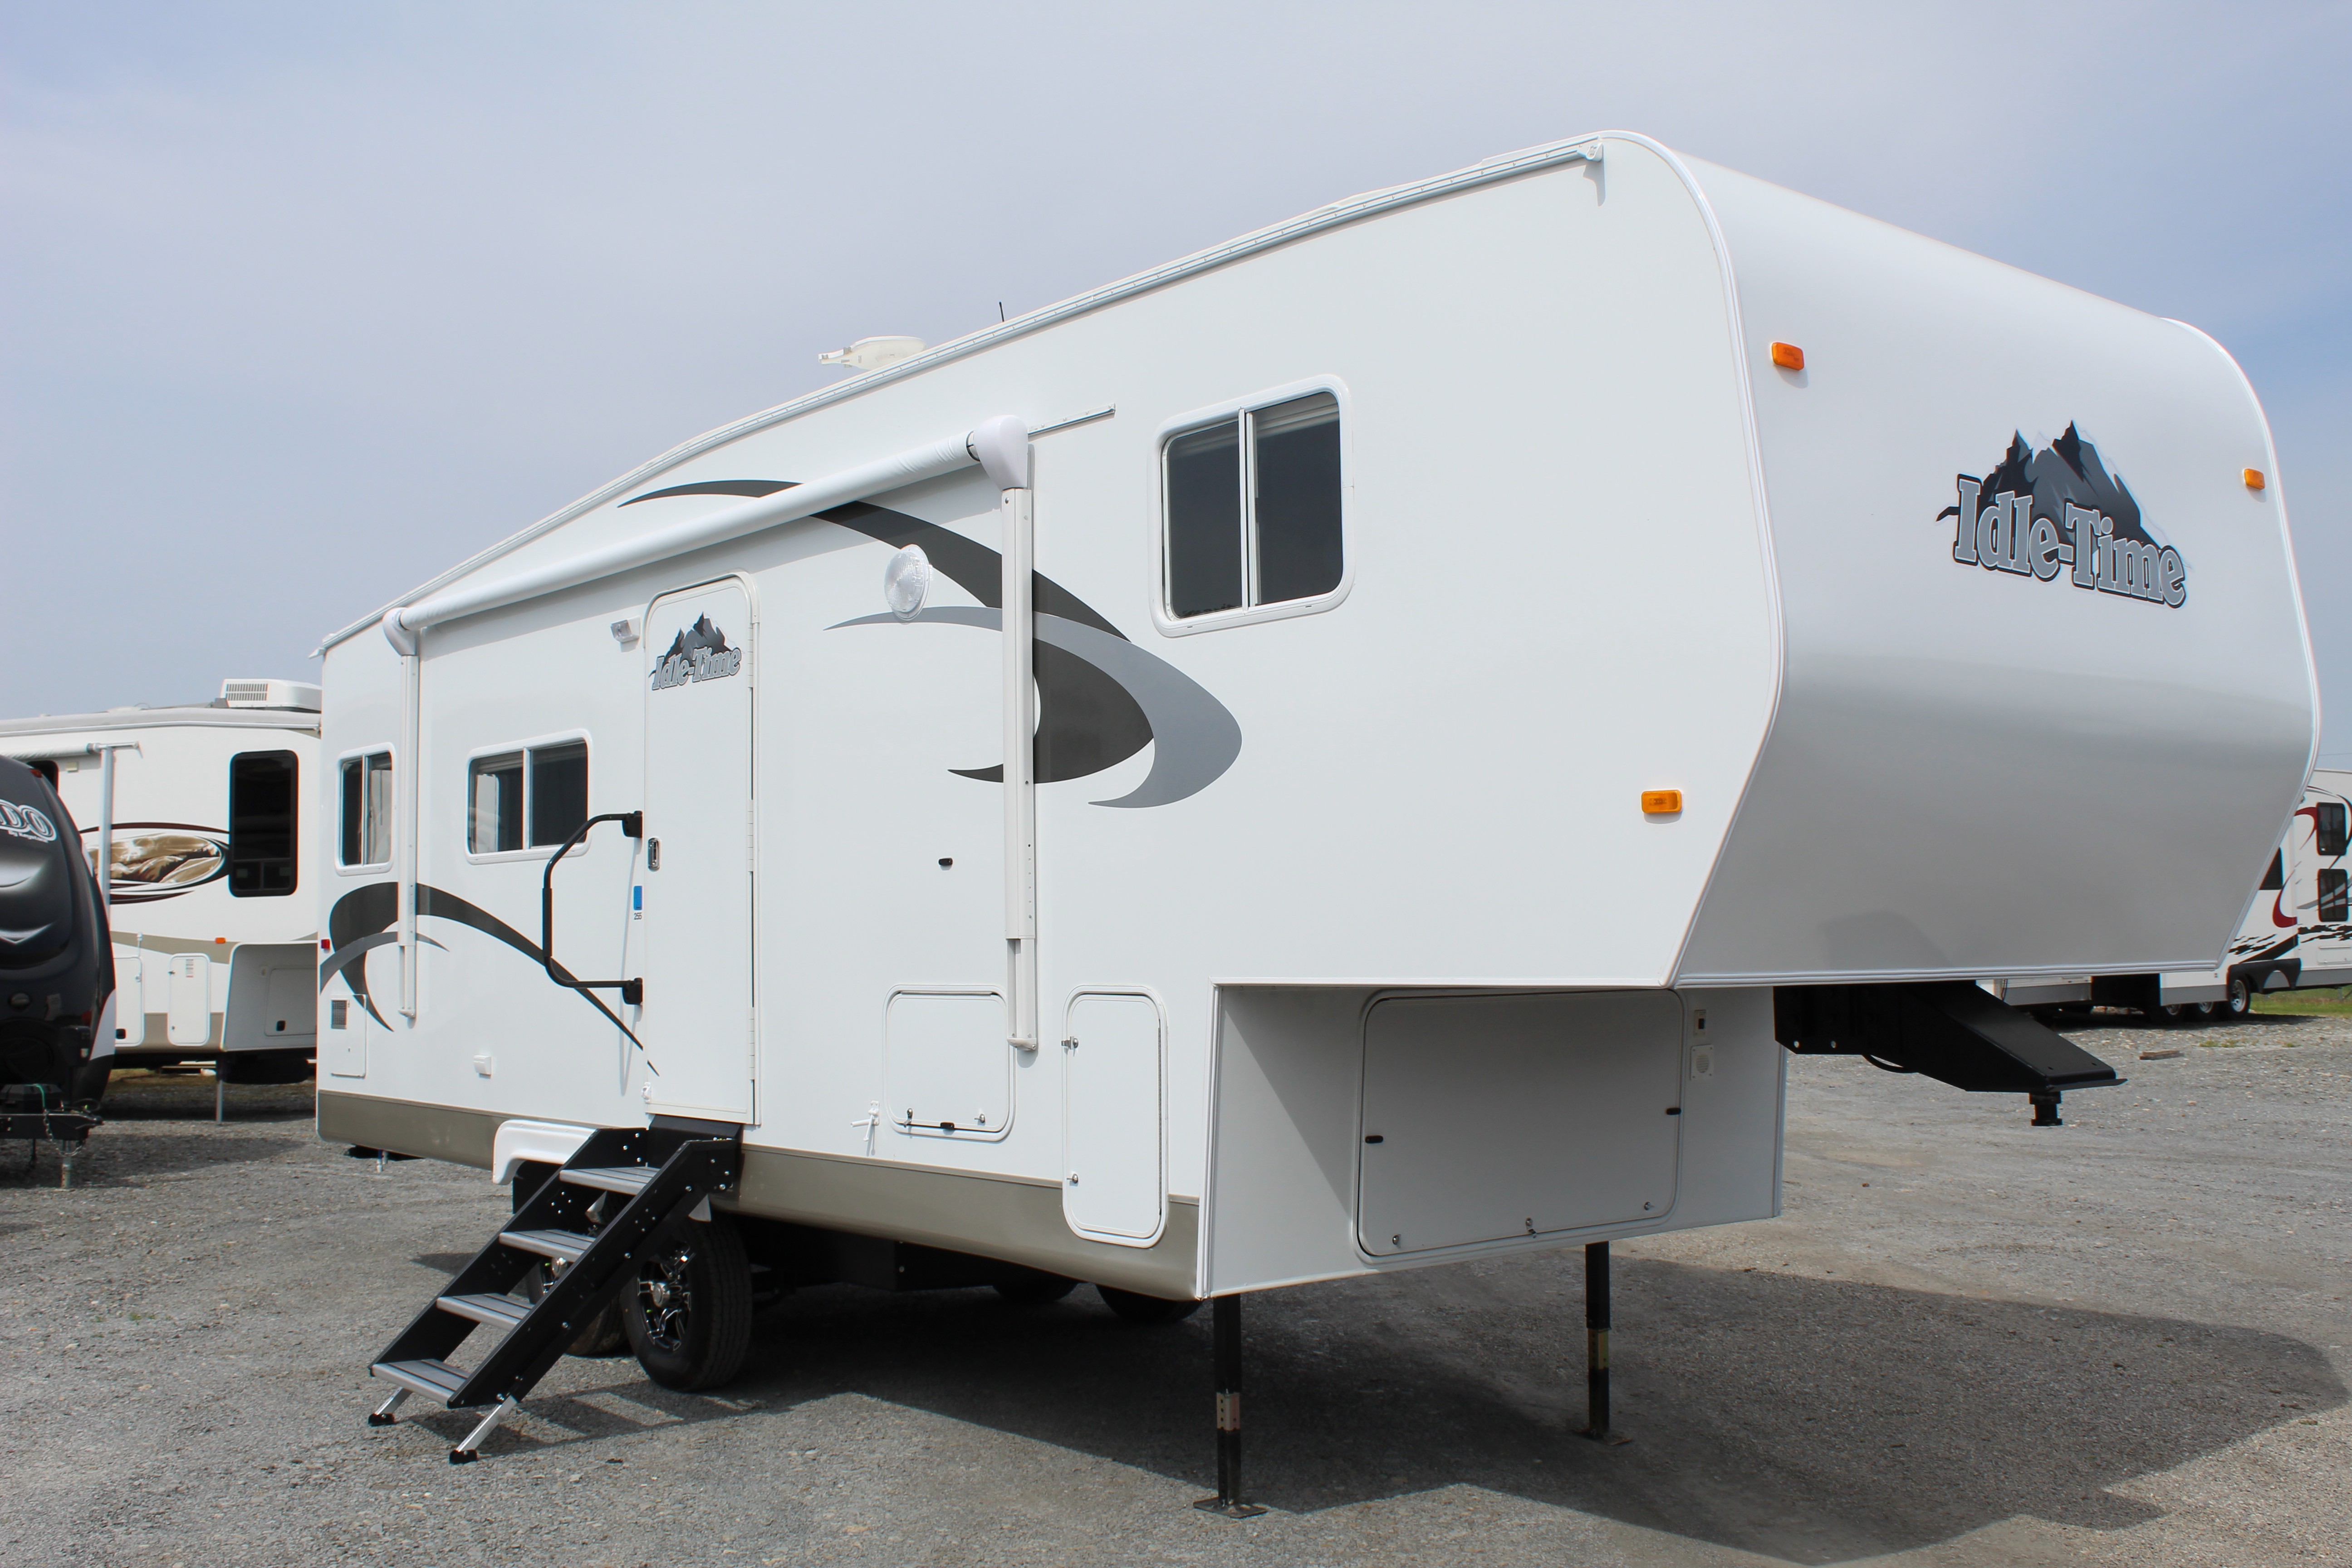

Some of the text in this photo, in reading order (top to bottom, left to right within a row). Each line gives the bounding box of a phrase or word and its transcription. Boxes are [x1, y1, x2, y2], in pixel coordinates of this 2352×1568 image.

[1953, 474, 2186, 609] Idle-Time
[652, 646, 742, 691] Idle-Time
[0, 799, 57, 841] DO
